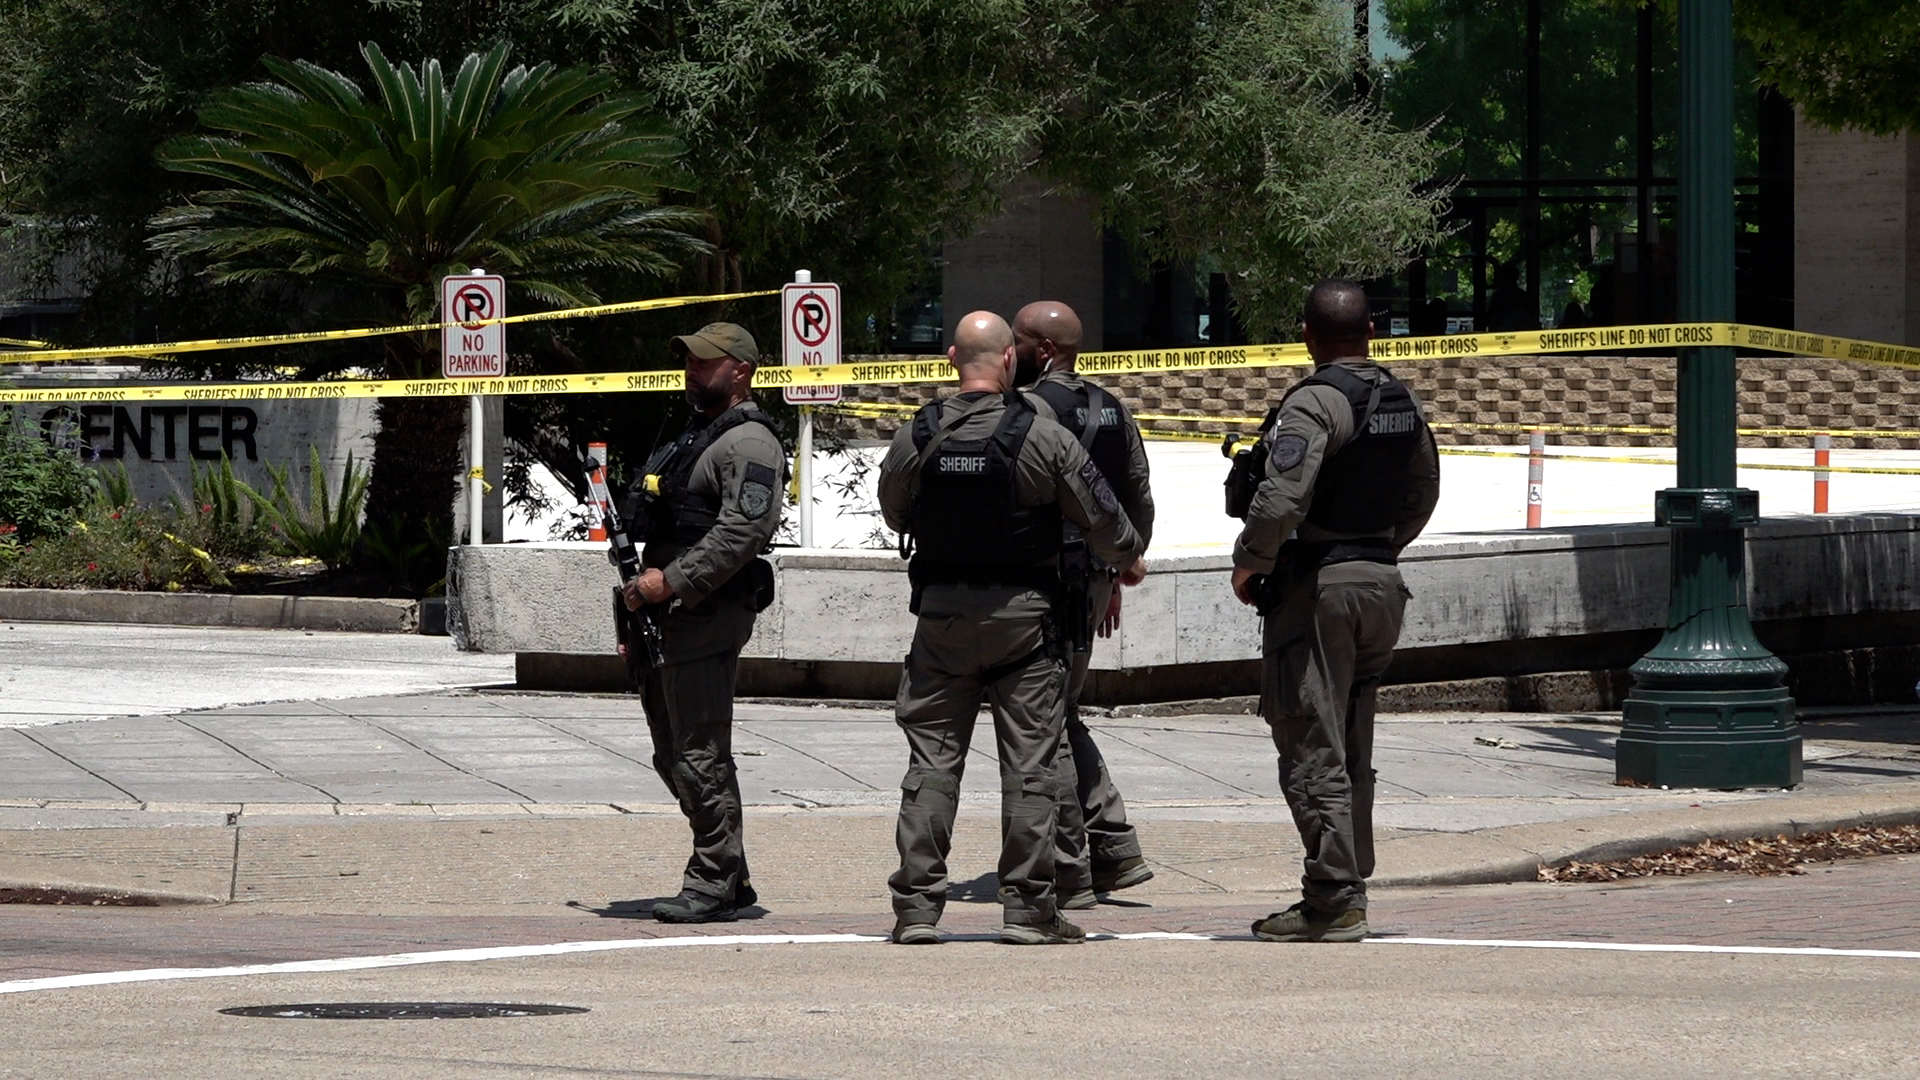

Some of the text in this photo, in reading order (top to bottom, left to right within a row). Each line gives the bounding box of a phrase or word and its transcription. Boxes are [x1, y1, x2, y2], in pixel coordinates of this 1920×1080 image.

[463, 334, 484, 352] NO
[1539, 332, 1596, 349] SHERIFF'S
[1600, 330, 1625, 346] LINE
[1629, 329, 1643, 345] DO
[1649, 328, 1671, 343] NOT
[1675, 327, 1713, 342] CROSS
[1368, 342, 1391, 358] INE
[1396, 341, 1410, 357] DO
[1415, 339, 1436, 356] NOT
[1440, 338, 1478, 355] CROSS
[449, 354, 498, 372] PARKING
[803, 351, 822, 366] NO
[1078, 355, 1133, 371] SHERIFF'S
[1137, 353, 1161, 368] LINE
[1166, 352, 1180, 367] DO
[1184, 351, 1206, 366] NOT
[1209, 349, 1246, 365] CROSS
[756, 369, 792, 385] CROSS
[852, 363, 953, 381] SHERIFF'S LINE DO
[405, 378, 568, 396] SHERIFF'S LINE DO NOT CROSS
[627, 374, 682, 389] SHERIFF'S
[267, 387, 282, 399] DO
[286, 386, 307, 398] NOT
[310, 385, 346, 398] CROSS
[1076, 408, 1118, 426] SIFF
[1369, 411, 1415, 434] SHERIFF
[40, 405, 258, 461] CENTER
[940, 456, 986, 472] SHERIFF
